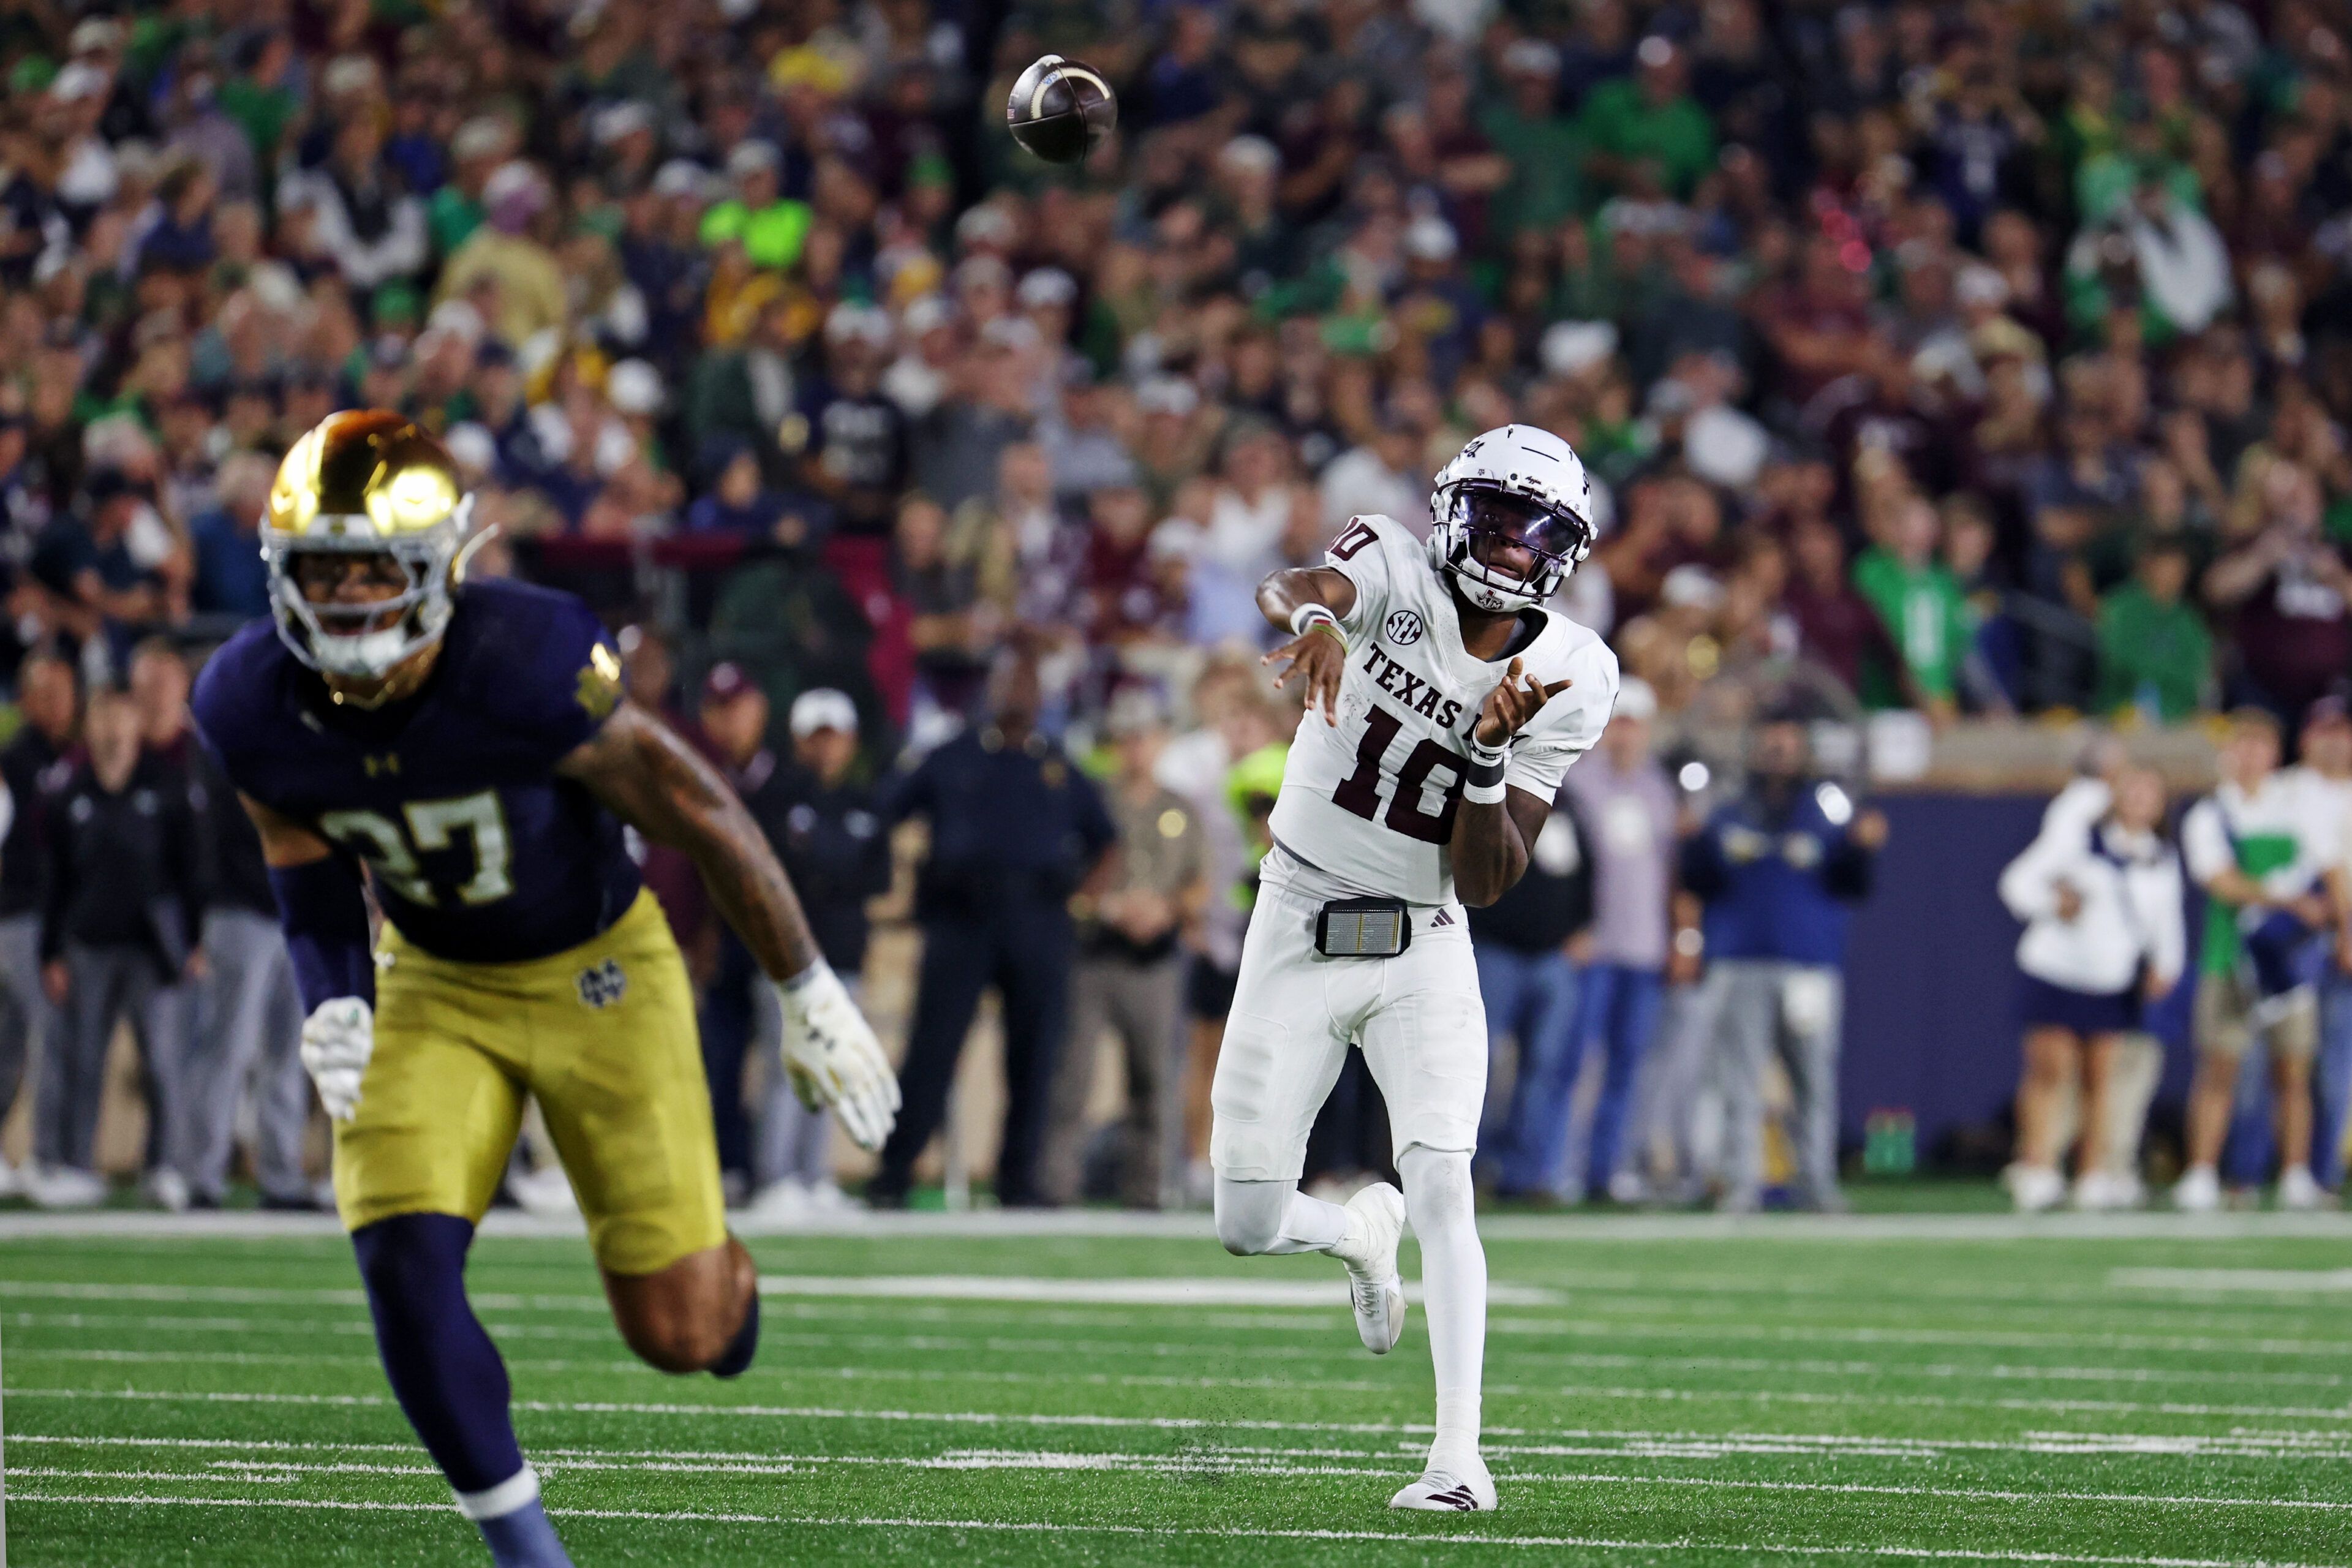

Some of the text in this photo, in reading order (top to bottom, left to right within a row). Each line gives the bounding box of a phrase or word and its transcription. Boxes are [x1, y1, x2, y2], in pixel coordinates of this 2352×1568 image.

[1386, 610, 1423, 646] SEC
[1362, 641, 1463, 729] TEXAS
[1331, 703, 1469, 845] 10
